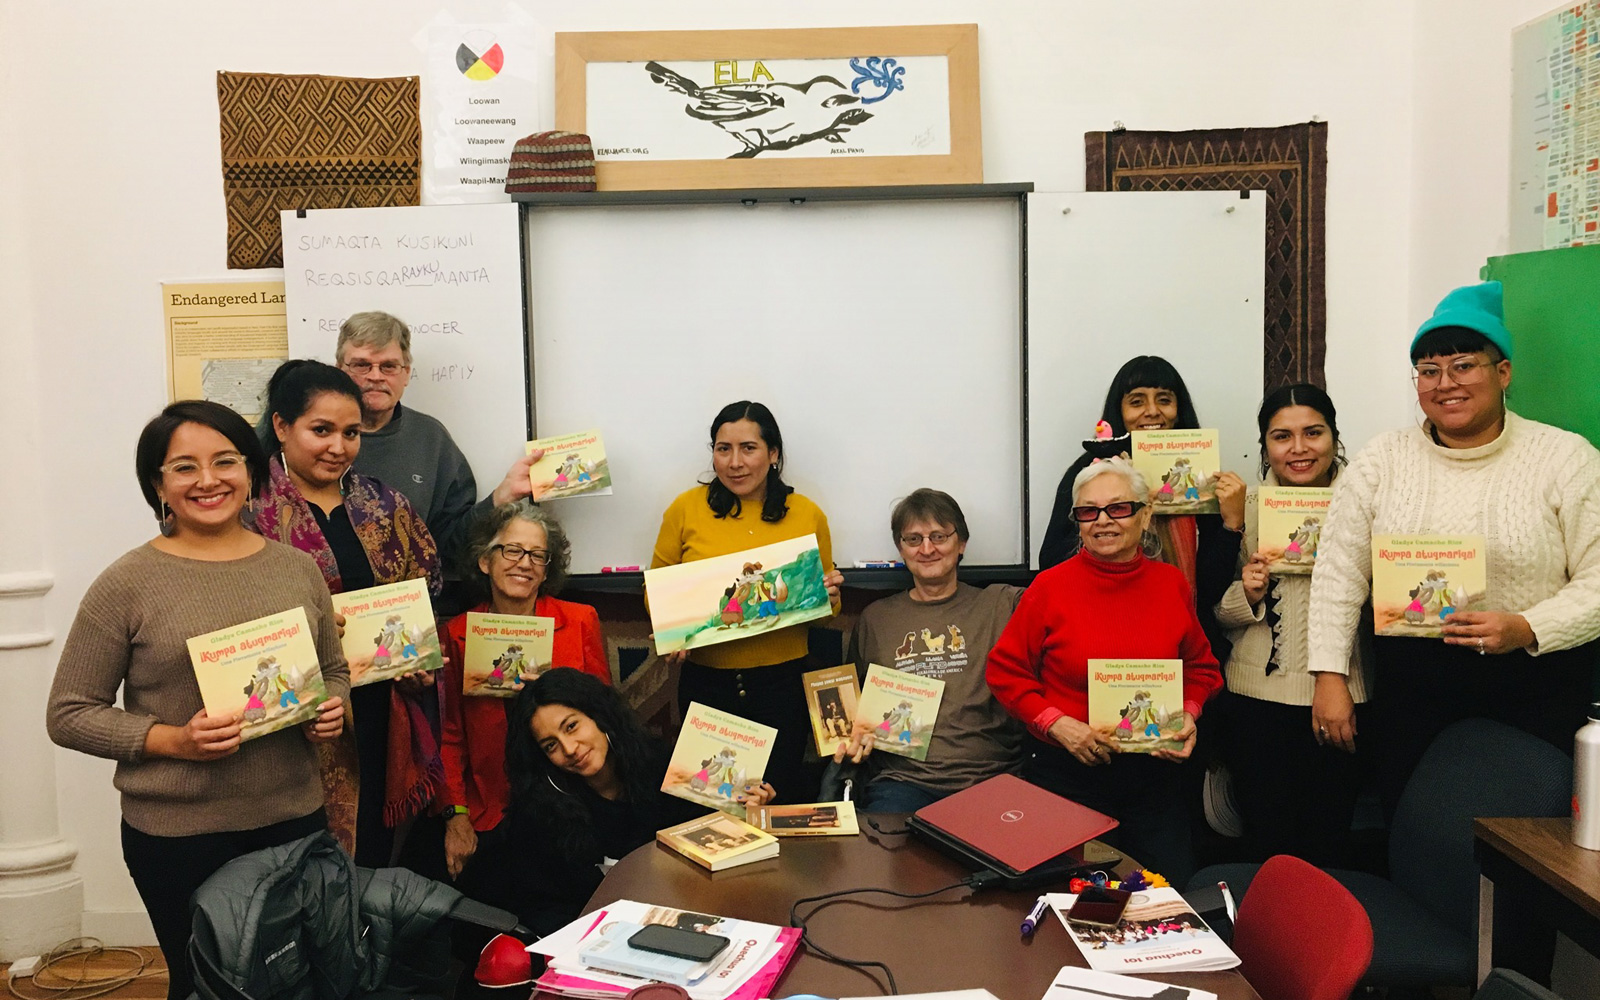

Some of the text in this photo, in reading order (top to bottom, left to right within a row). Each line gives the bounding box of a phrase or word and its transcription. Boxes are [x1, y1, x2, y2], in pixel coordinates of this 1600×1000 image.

[713, 61, 774, 85] ELA
[468, 97, 500, 105] Loowan
[454, 117, 516, 126] Loowaneewang
[467, 137, 506, 146] Waapeew
[298, 231, 475, 251] SUMAQTA KUSIKUNI
[171, 292, 259, 308] Endangered
[1379, 548, 1412, 561] ¡Kumpa
[210, 617, 284, 644] Gladys Camacho Rios
[199, 622, 301, 663] ¡Kumpa atuqmariqa!
[1094, 671, 1123, 683] ¡Kumpa
[727, 939, 757, 969] Quechua
[1145, 948, 1203, 962] Quechua
